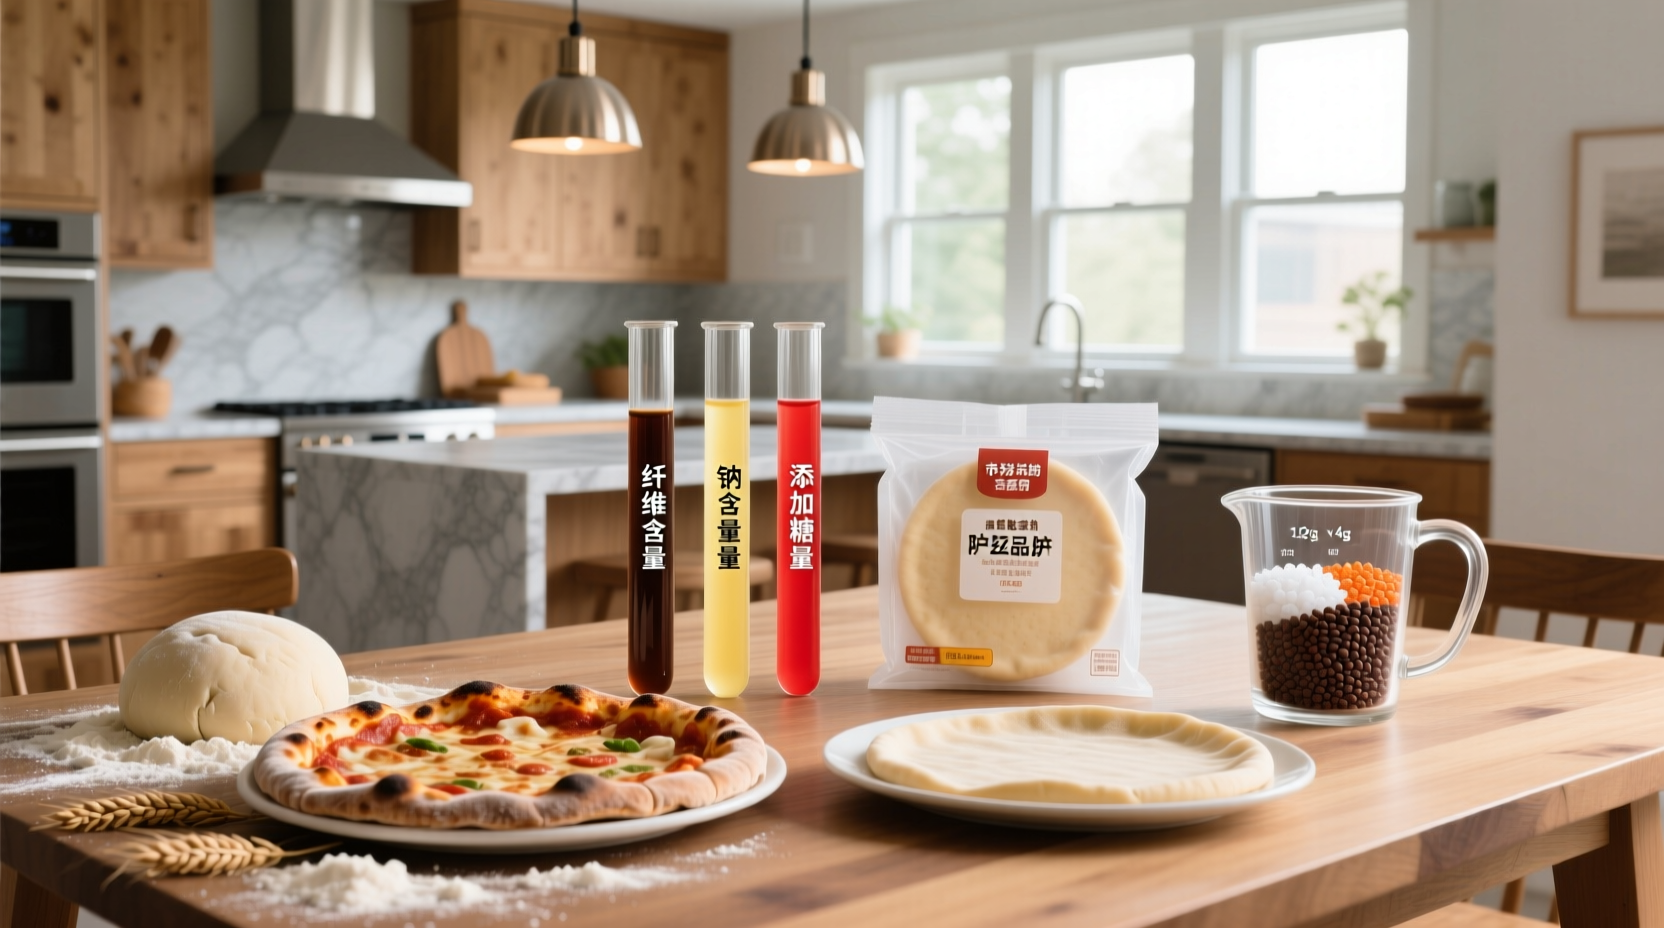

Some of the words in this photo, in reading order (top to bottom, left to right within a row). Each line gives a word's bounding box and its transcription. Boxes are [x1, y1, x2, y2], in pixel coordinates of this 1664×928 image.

[641, 463, 667, 570] 纤维含量
[716, 464, 742, 570] 钠含量量
[789, 463, 815, 570] 添加糖量
